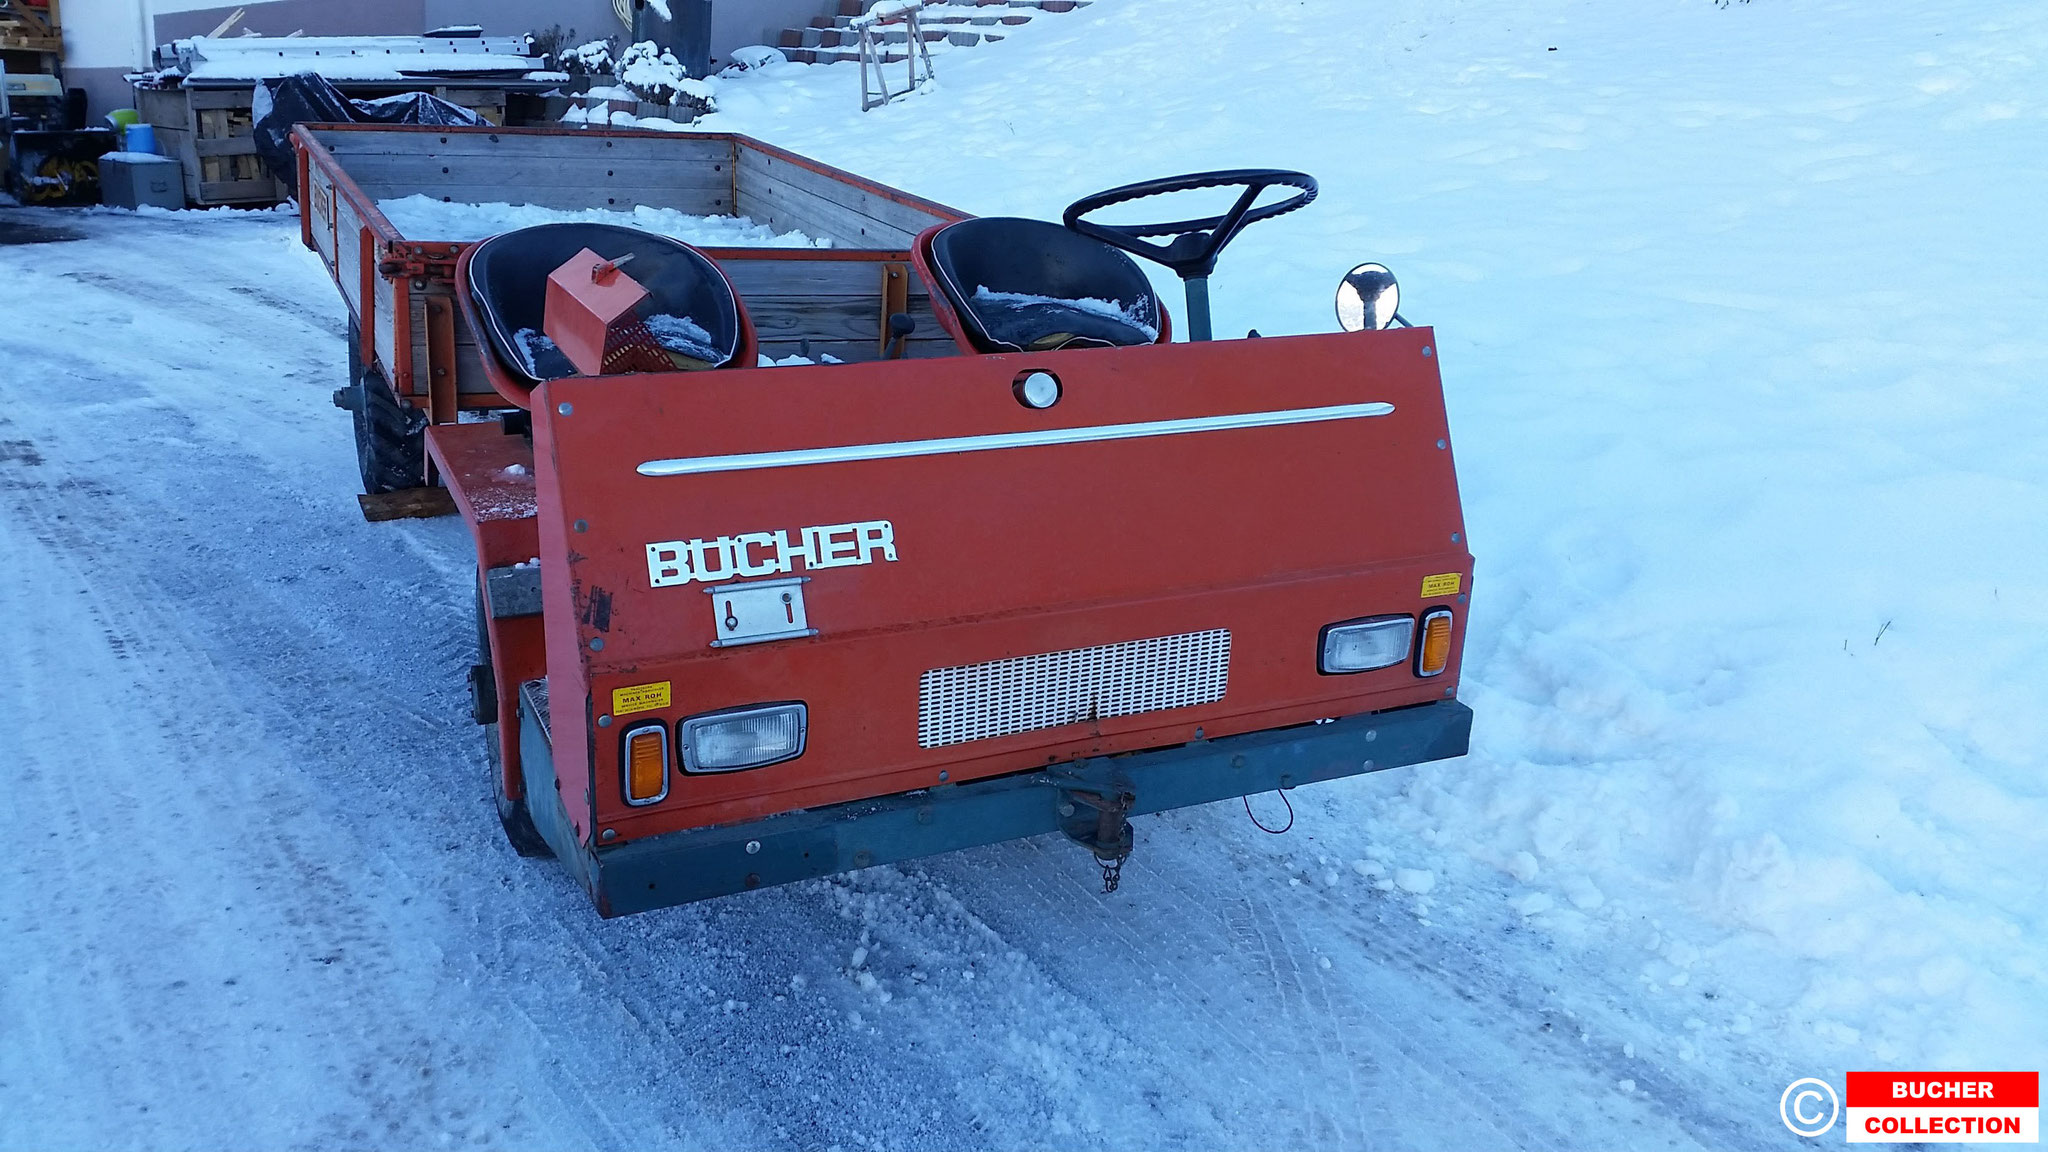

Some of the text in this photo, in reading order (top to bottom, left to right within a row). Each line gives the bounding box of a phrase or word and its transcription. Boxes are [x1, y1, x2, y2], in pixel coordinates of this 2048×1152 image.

[646, 520, 899, 588] BUCHER
[622, 695, 641, 704] MAX
[644, 692, 662, 700] ROH
